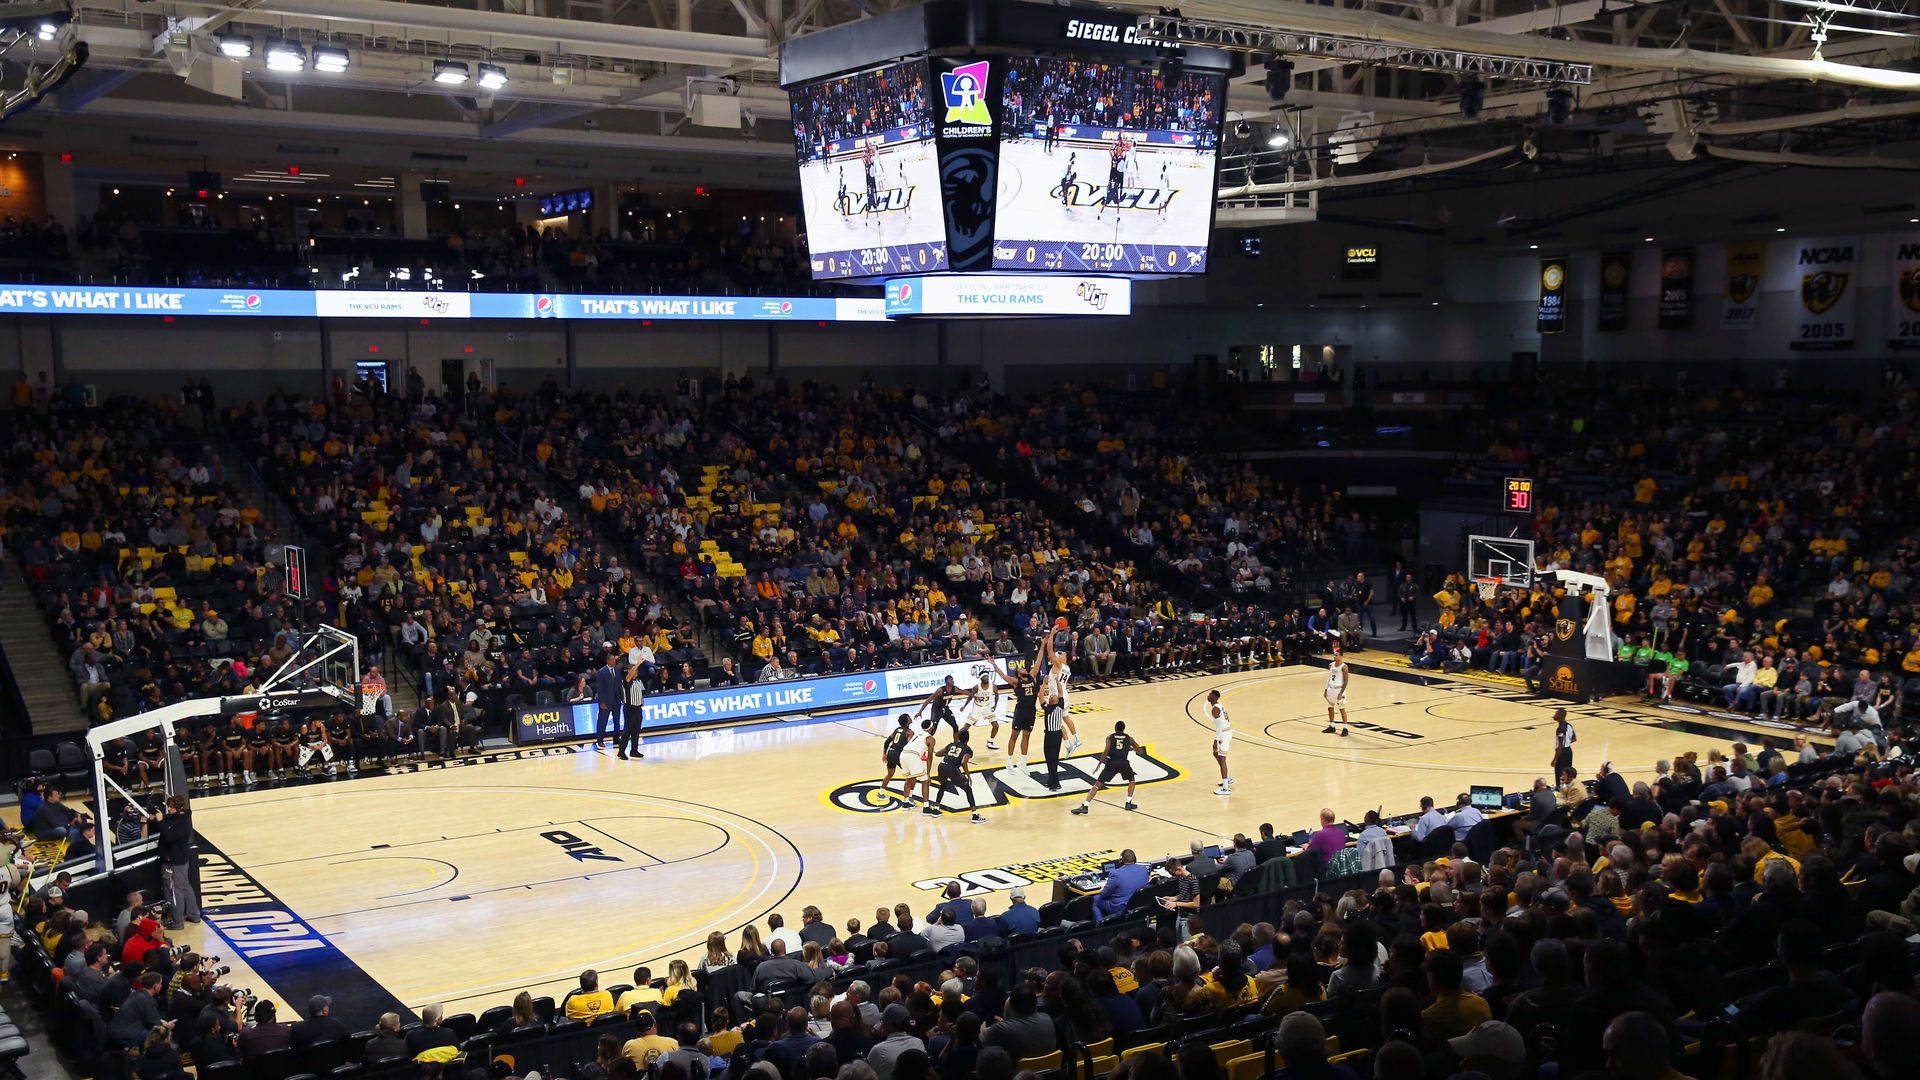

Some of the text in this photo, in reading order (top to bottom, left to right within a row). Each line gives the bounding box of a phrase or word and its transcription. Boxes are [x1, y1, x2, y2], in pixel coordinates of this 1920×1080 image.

[1066, 20, 1120, 42] SIEGEL
[943, 126, 991, 134] CHILDREN'S
[860, 248, 888, 266] 20:00
[920, 248, 926, 265] 0
[1026, 246, 1035, 262] 0
[1082, 244, 1124, 260] 20:00
[1168, 250, 1176, 266] 0
[1356, 248, 1376, 256] VCU
[1799, 246, 1853, 265] NCAA
[1898, 244, 1920, 260] NC
[829, 258, 836, 272] 0
[52, 291, 119, 308] WHAT
[124, 292, 130, 308] I
[134, 293, 182, 310] LIKE
[958, 294, 1043, 304] THE VCU RAMS
[580, 300, 735, 315] THAT'S WHAT I LIKE
[1801, 323, 1844, 338] 2005
[1899, 322, 1920, 336] 20
[1512, 492, 1528, 508] 30
[1060, 672, 1068, 683] 14
[1549, 676, 1578, 690] SCHELL
[897, 682, 912, 691] THE
[914, 680, 929, 689] VCU
[1024, 687, 1033, 696] 21
[642, 688, 813, 720] THAT'S WHAT I LIKE
[533, 712, 560, 724] VCU
[536, 722, 572, 736] Health.
[894, 732, 901, 744] 0
[1116, 739, 1124, 750] 5
[948, 746, 962, 758] 23
[1115, 971, 1132, 980] VCU
